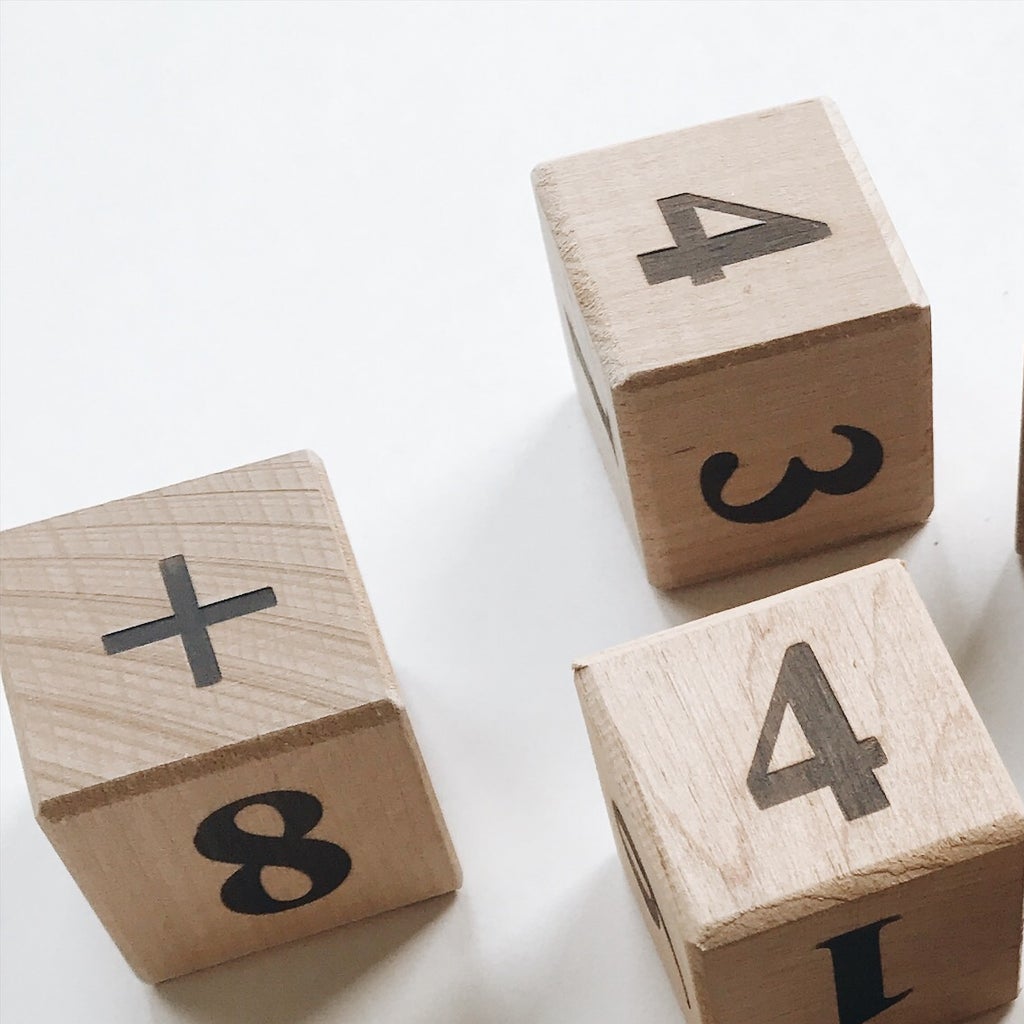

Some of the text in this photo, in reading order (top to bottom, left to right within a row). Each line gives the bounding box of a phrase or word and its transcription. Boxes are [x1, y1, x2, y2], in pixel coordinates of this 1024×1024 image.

[637, 192, 832, 286] 4
[700, 424, 884, 524] 3
[746, 640, 891, 822] 4
[193, 790, 352, 915] 8
